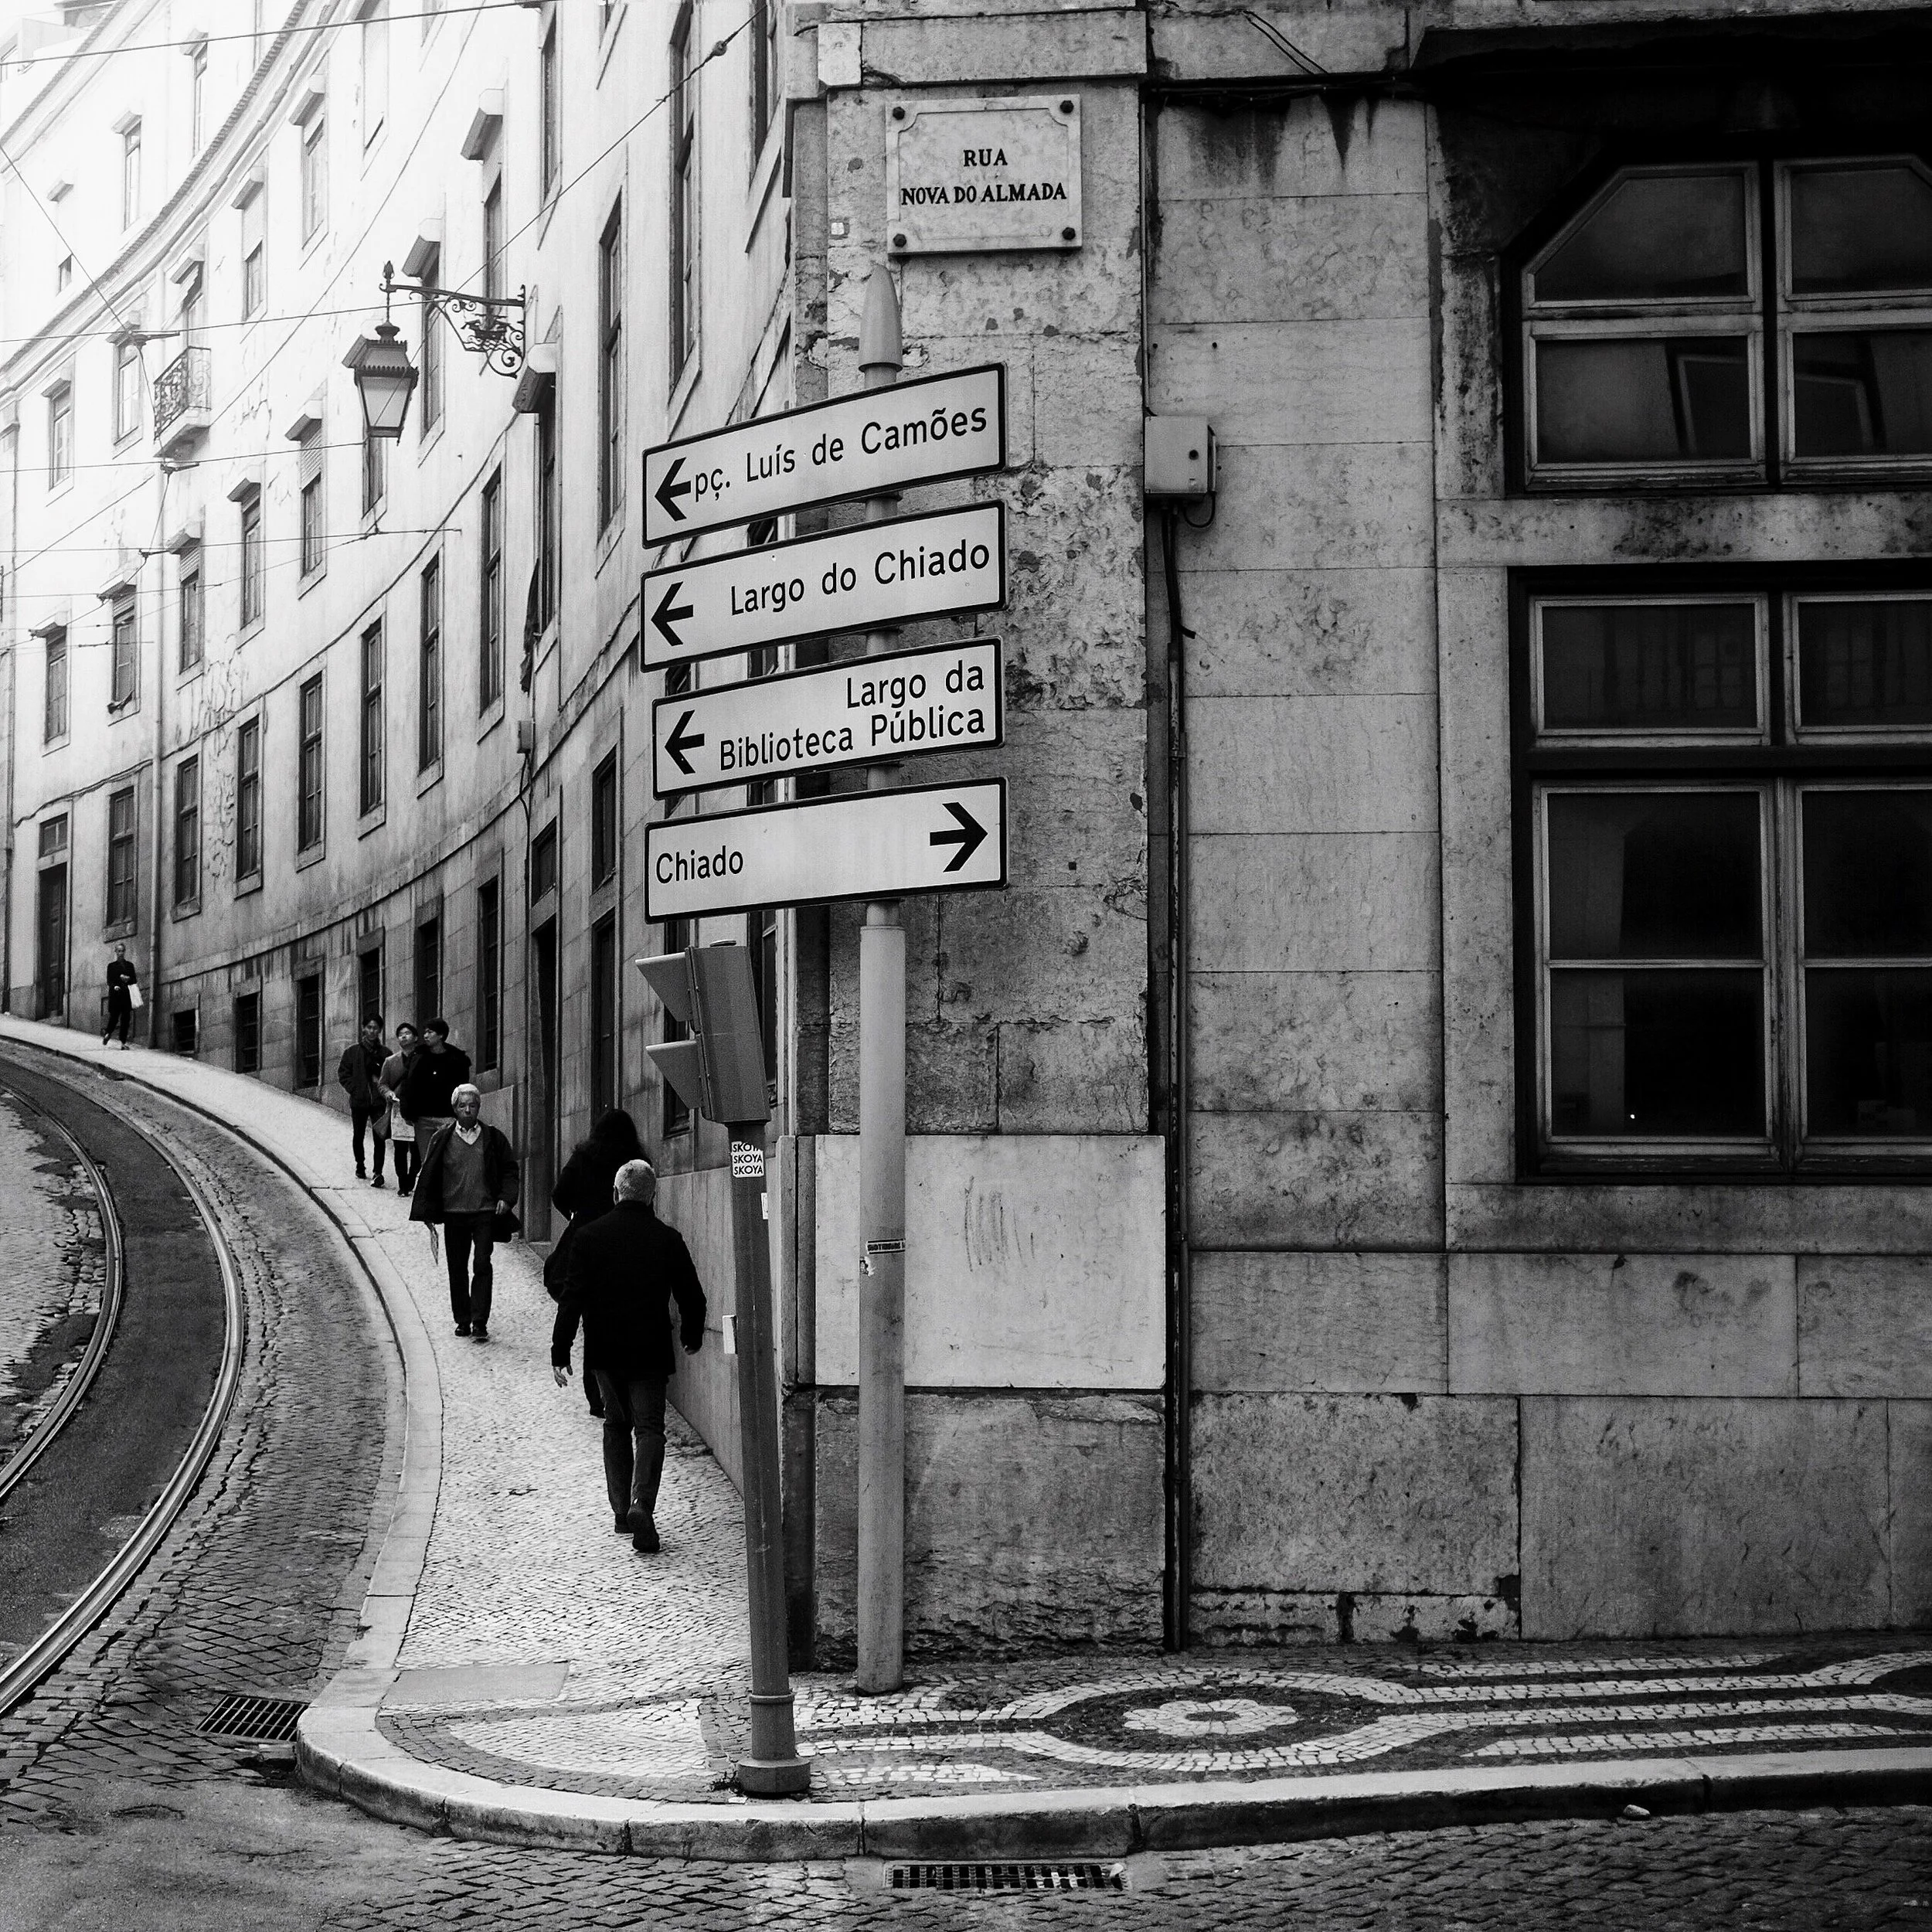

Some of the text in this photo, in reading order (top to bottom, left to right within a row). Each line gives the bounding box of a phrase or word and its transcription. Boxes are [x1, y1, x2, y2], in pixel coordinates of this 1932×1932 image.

[963, 148, 1009, 168] RUA
[900, 182, 1067, 206] NOVA DO ALMADA
[695, 406, 988, 503] pç. Luís de Camões
[730, 539, 991, 617] Largo do Chiado
[846, 659, 985, 709] Largo da
[719, 703, 986, 772] Biblioteca Pública
[655, 845, 744, 885] Chiado
[733, 1154, 763, 1164] SKOYA
[733, 1165, 764, 1175] SKOYA
